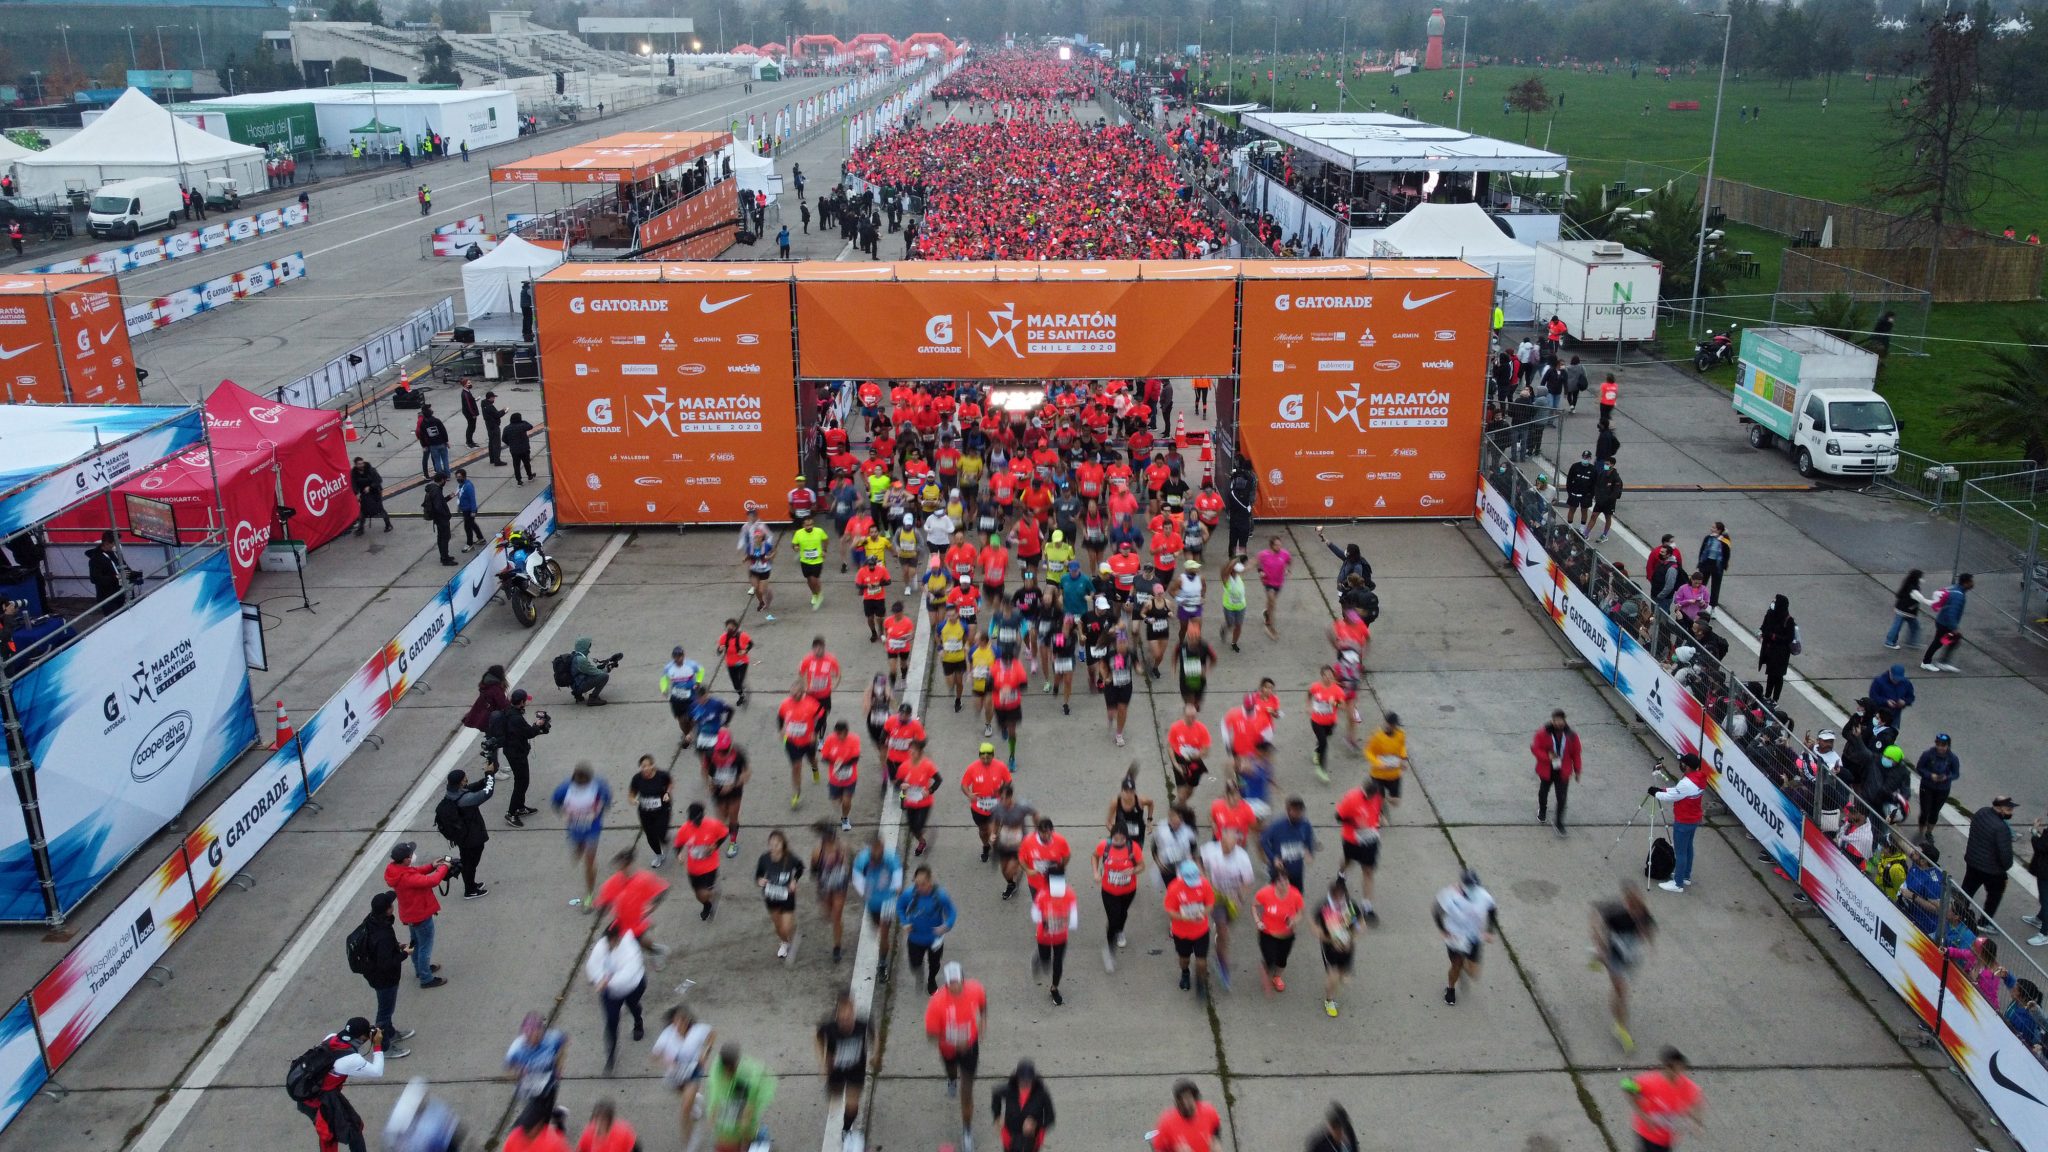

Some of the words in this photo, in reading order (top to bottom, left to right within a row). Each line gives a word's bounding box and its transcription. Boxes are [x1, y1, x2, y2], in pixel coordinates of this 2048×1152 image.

[245, 121, 276, 139] Hospital
[277, 120, 288, 134] del
[140, 247, 160, 258] GATORADE
[212, 284, 234, 297] GATORADE
[0, 306, 25, 315] RATÓN
[590, 299, 668, 312] GATORADE
[1295, 296, 1373, 308] GATORADE
[1596, 306, 1646, 315] UNIBOXS
[127, 311, 154, 326] GATORADE
[1027, 311, 1117, 328] MARATÓN
[1027, 331, 1046, 340] DE
[1048, 330, 1116, 340] SANTIAGO
[918, 346, 962, 354] GATORADE
[1032, 344, 1072, 352] CHILE
[1320, 361, 1351, 369] publimetro
[678, 394, 760, 409] MARATÓN
[1370, 390, 1450, 405] MARATÓN
[258, 404, 287, 422] Prokart
[680, 412, 696, 421] DE
[699, 411, 762, 421] SANTIAGO
[1370, 407, 1385, 416] DE
[1388, 406, 1448, 416] SANTIAGO
[308, 473, 349, 506] Prokart
[1486, 502, 1509, 536] GATORADE
[239, 523, 271, 555] Prokar
[408, 613, 445, 662] GATORADE
[1570, 606, 1607, 653] GATORADE
[151, 638, 192, 675] MARATÓN
[154, 674, 162, 685] DE
[164, 651, 194, 678] SANTIAGO
[104, 714, 126, 736] GATORADE
[136, 720, 185, 766] cooperativa
[1726, 764, 1784, 840] GATORADE
[226, 774, 289, 849] GATORADE
[1836, 873, 1863, 910] Hospital
[1864, 906, 1876, 922] del
[1836, 888, 1874, 935] Trabajador
[84, 943, 119, 981] Hospital
[120, 927, 132, 948] del
[90, 945, 134, 994] Trabajador
